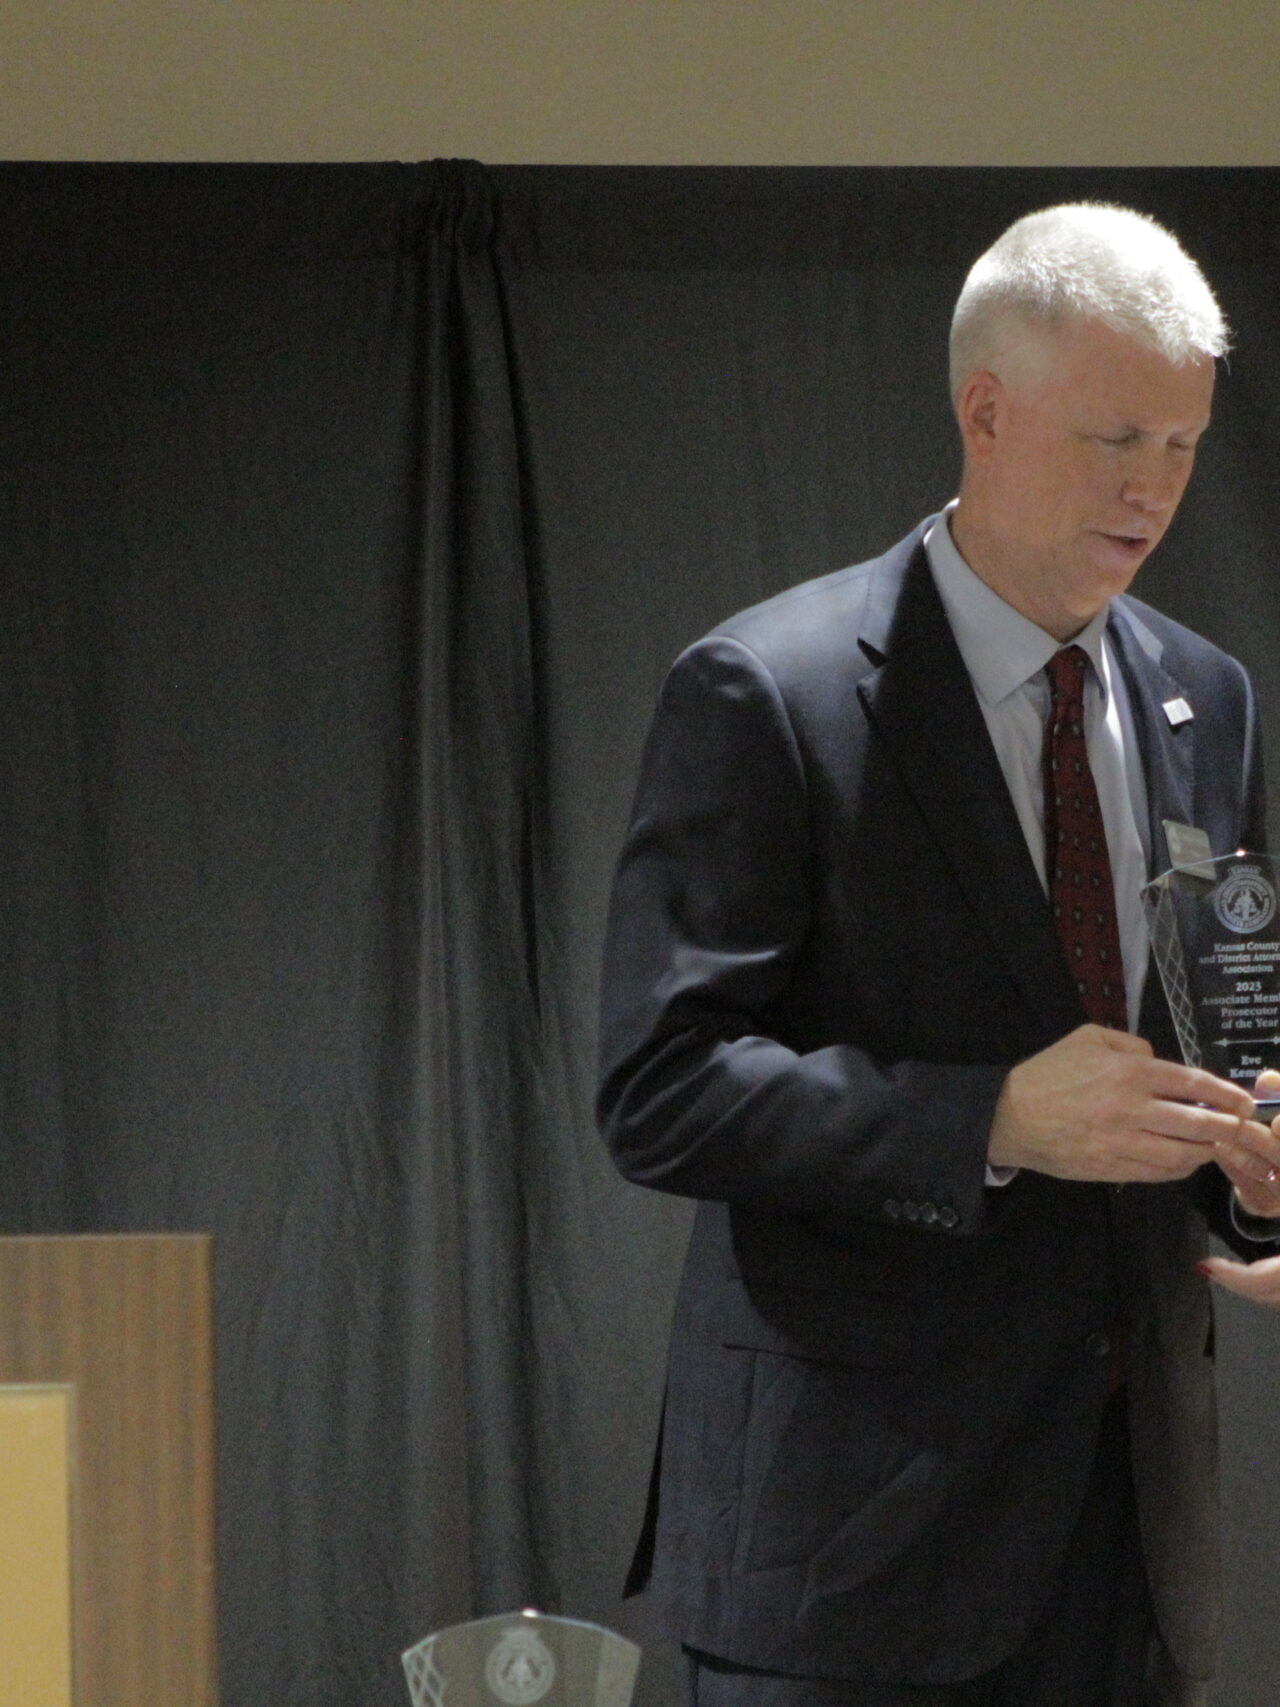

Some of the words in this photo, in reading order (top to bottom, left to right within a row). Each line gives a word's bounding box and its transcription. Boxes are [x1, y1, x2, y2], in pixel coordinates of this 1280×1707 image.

[1214, 943, 1245, 952] Kansas
[1247, 941, 1280, 952] County
[1199, 955, 1215, 964] and
[1217, 953, 1251, 963] District
[1222, 964, 1274, 974] Association
[1235, 981, 1262, 992] 2023
[1221, 1006, 1278, 1017] Prosecutor
[1221, 1020, 1232, 1029] of
[1235, 1019, 1253, 1028] the
[1255, 1018, 1279, 1028] Year
